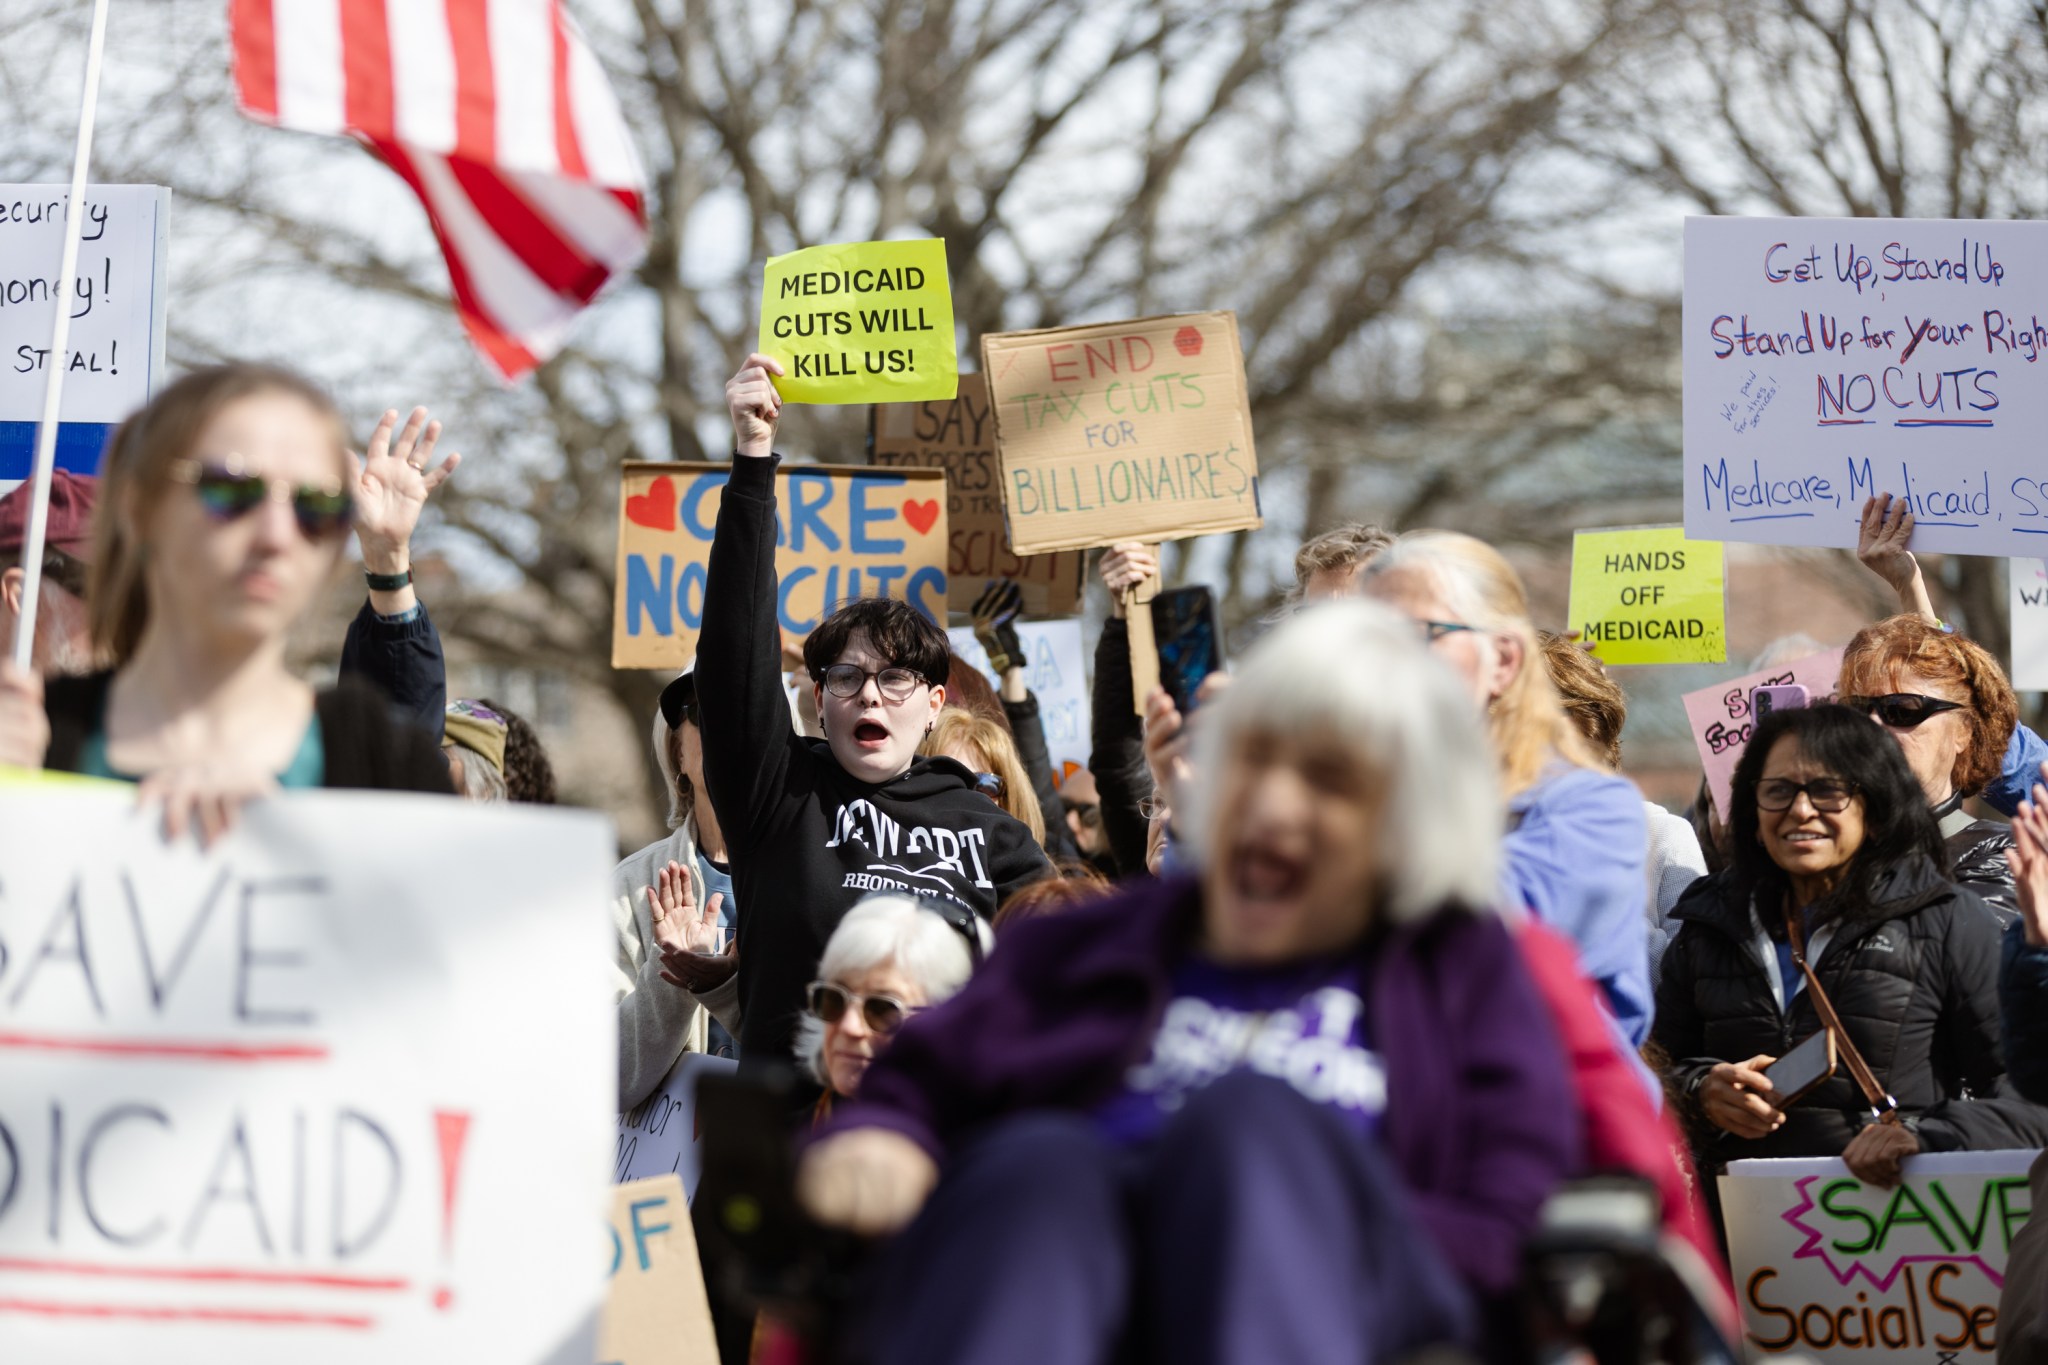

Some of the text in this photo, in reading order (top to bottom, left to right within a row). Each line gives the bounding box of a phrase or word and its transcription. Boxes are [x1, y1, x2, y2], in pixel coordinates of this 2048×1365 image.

[0, 195, 108, 241] ecuriy
[0, 257, 110, 318] oney!
[780, 267, 925, 299] MEDICAID
[1764, 238, 2004, 294] Get Up, Stand Up
[773, 307, 934, 338] CUTS WILL
[1710, 310, 1815, 359] Stand
[1819, 313, 1853, 355] Up
[1860, 316, 1896, 350] for
[14, 339, 118, 375] STAL!
[794, 349, 915, 378] KILL US!
[1045, 336, 1154, 382] END
[1009, 372, 1206, 431] TAX CUTS
[1817, 366, 1999, 418] NO CUTS
[915, 395, 990, 447] SAY
[1085, 420, 1138, 448] FOR
[1703, 457, 1841, 512] Medicare,
[680, 467, 907, 554] CRE
[1604, 551, 1686, 574] HANDS
[1620, 585, 1665, 606] OFF
[1583, 619, 1704, 642] MEDICAID
[0, 864, 331, 1026] AVE
[1746, 1264, 1926, 1352] Social
